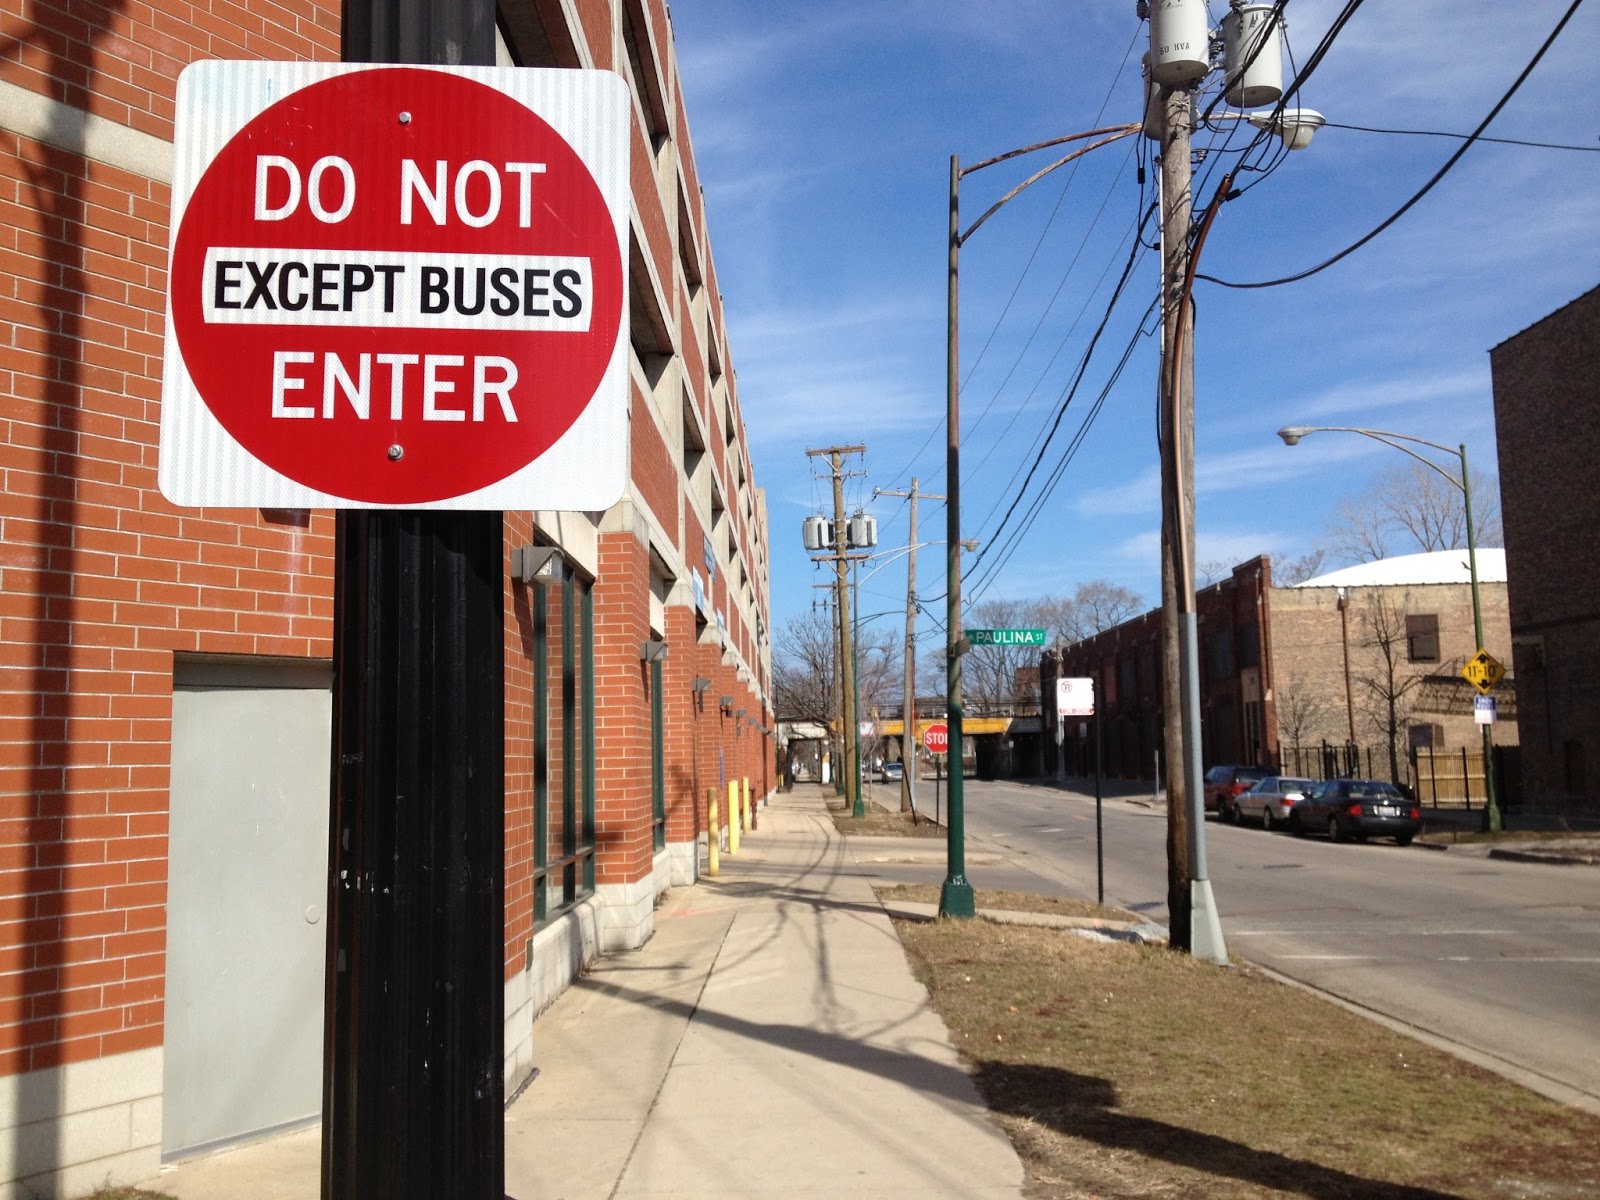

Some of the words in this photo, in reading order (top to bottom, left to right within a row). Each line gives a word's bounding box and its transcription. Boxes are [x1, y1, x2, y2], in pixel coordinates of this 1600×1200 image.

[254, 154, 356, 224] DO
[399, 159, 547, 228] NOT
[214, 260, 405, 313] EXCEPT
[419, 266, 583, 319] BUSES
[271, 350, 519, 423] ENTER
[976, 631, 1034, 644] PAULINA
[1036, 633, 1043, 641] ST
